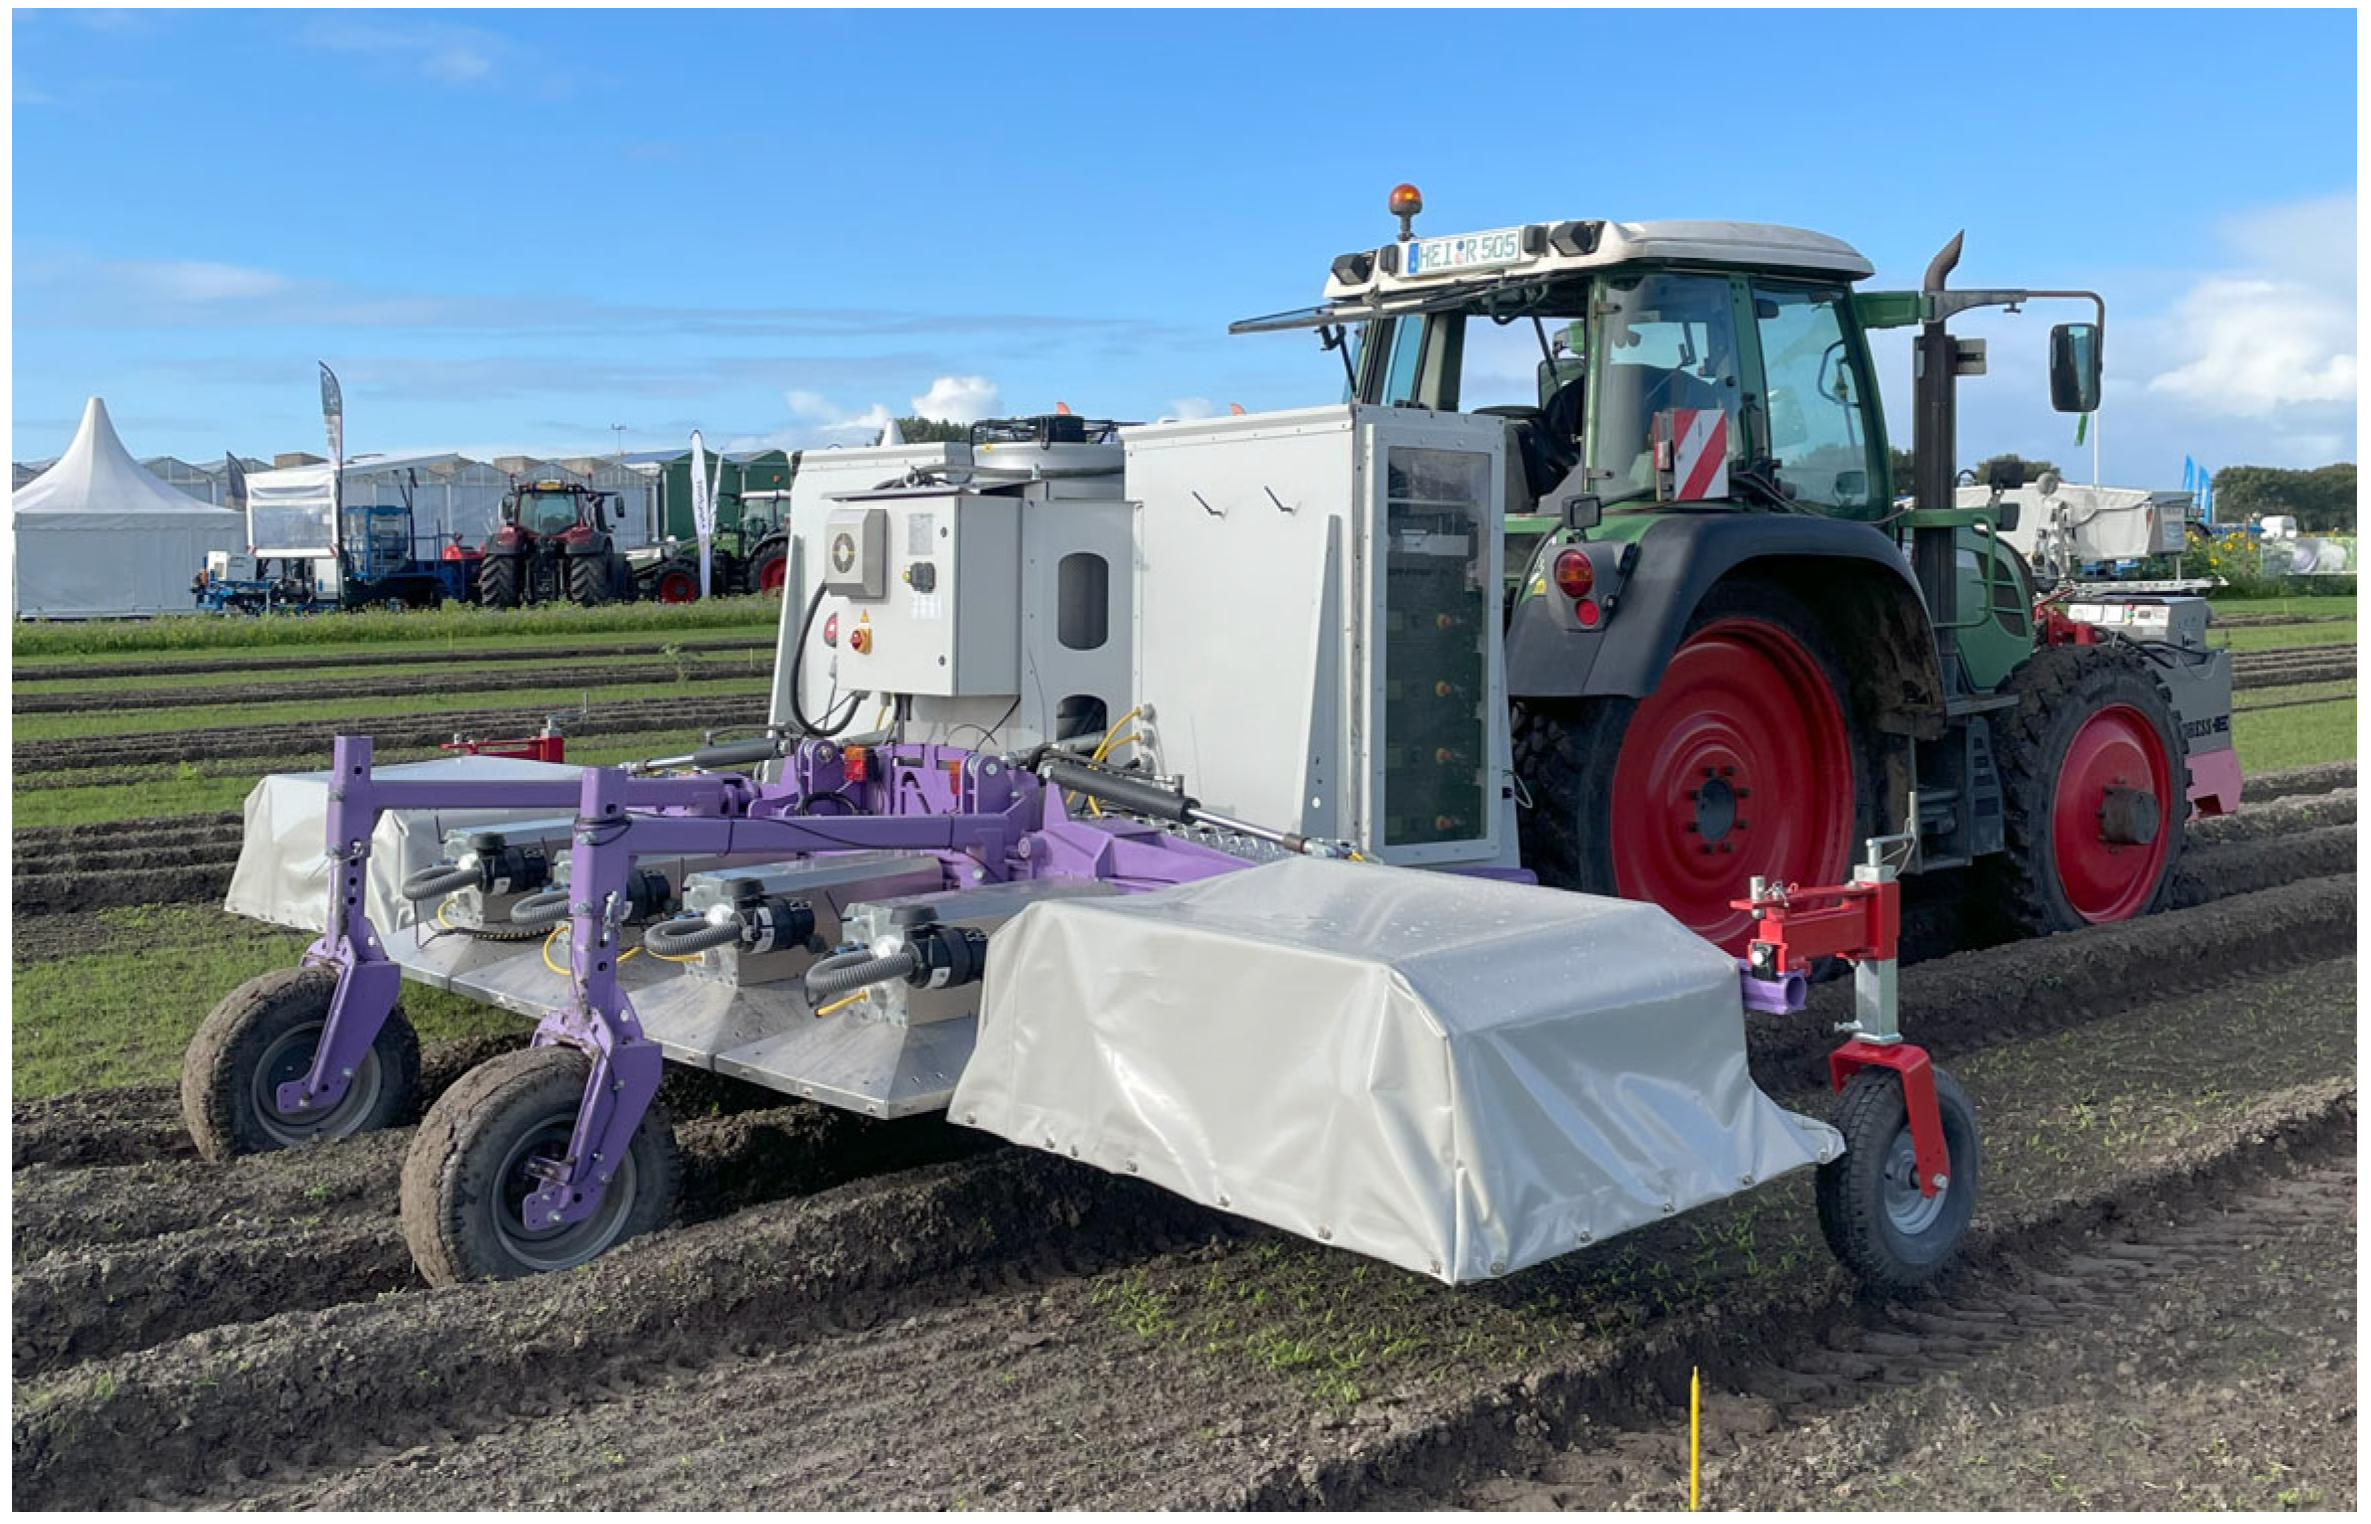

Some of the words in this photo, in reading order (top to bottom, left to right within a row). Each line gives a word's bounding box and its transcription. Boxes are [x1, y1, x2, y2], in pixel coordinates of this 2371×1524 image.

[1420, 242, 1453, 269] HEI
[1466, 238, 1478, 263] R
[1481, 232, 1517, 260] 505
